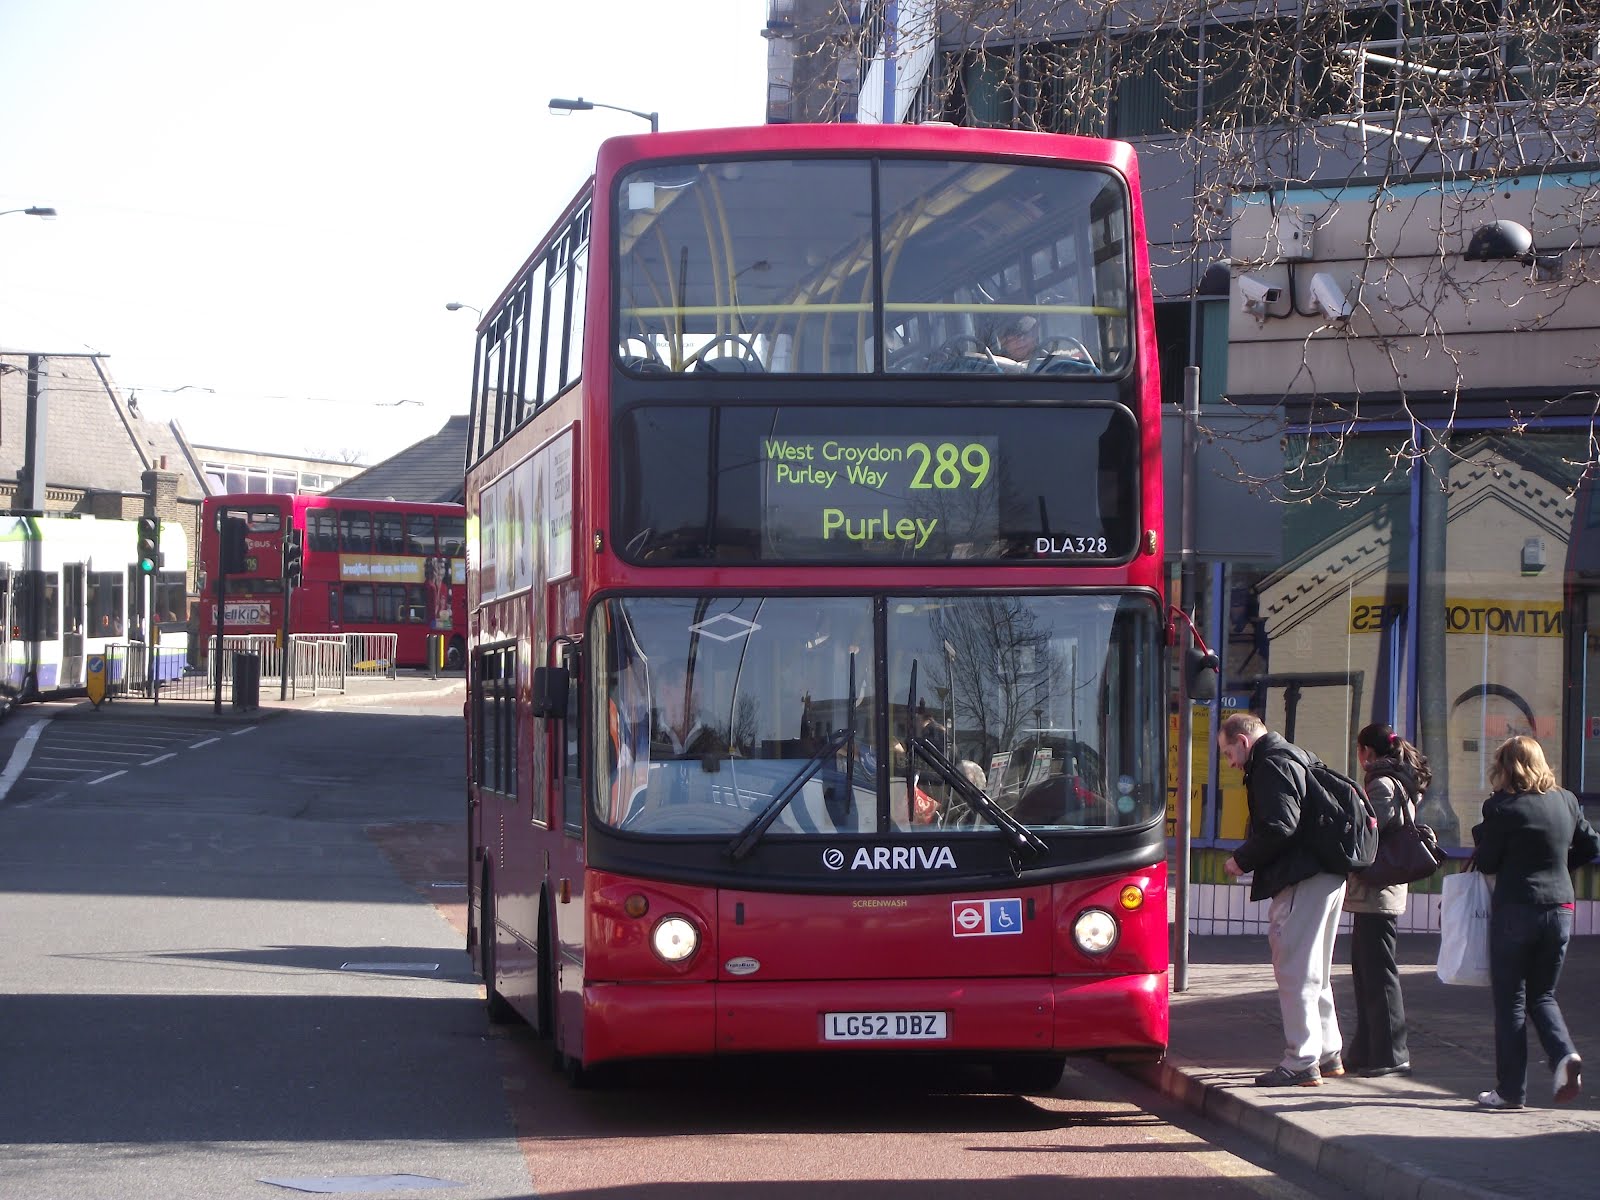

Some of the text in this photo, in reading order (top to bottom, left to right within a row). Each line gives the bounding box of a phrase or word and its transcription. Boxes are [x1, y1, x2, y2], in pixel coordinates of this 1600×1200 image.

[765, 440, 902, 465] West Croydon
[777, 463, 888, 488] Purley Way
[906, 442, 991, 488] 289
[822, 508, 938, 549] Purley
[1036, 537, 1107, 553] DLA328
[851, 846, 957, 870] ARRIVA
[852, 899, 908, 908] SCREENWASH
[833, 1015, 937, 1036] LG52 DBZ
